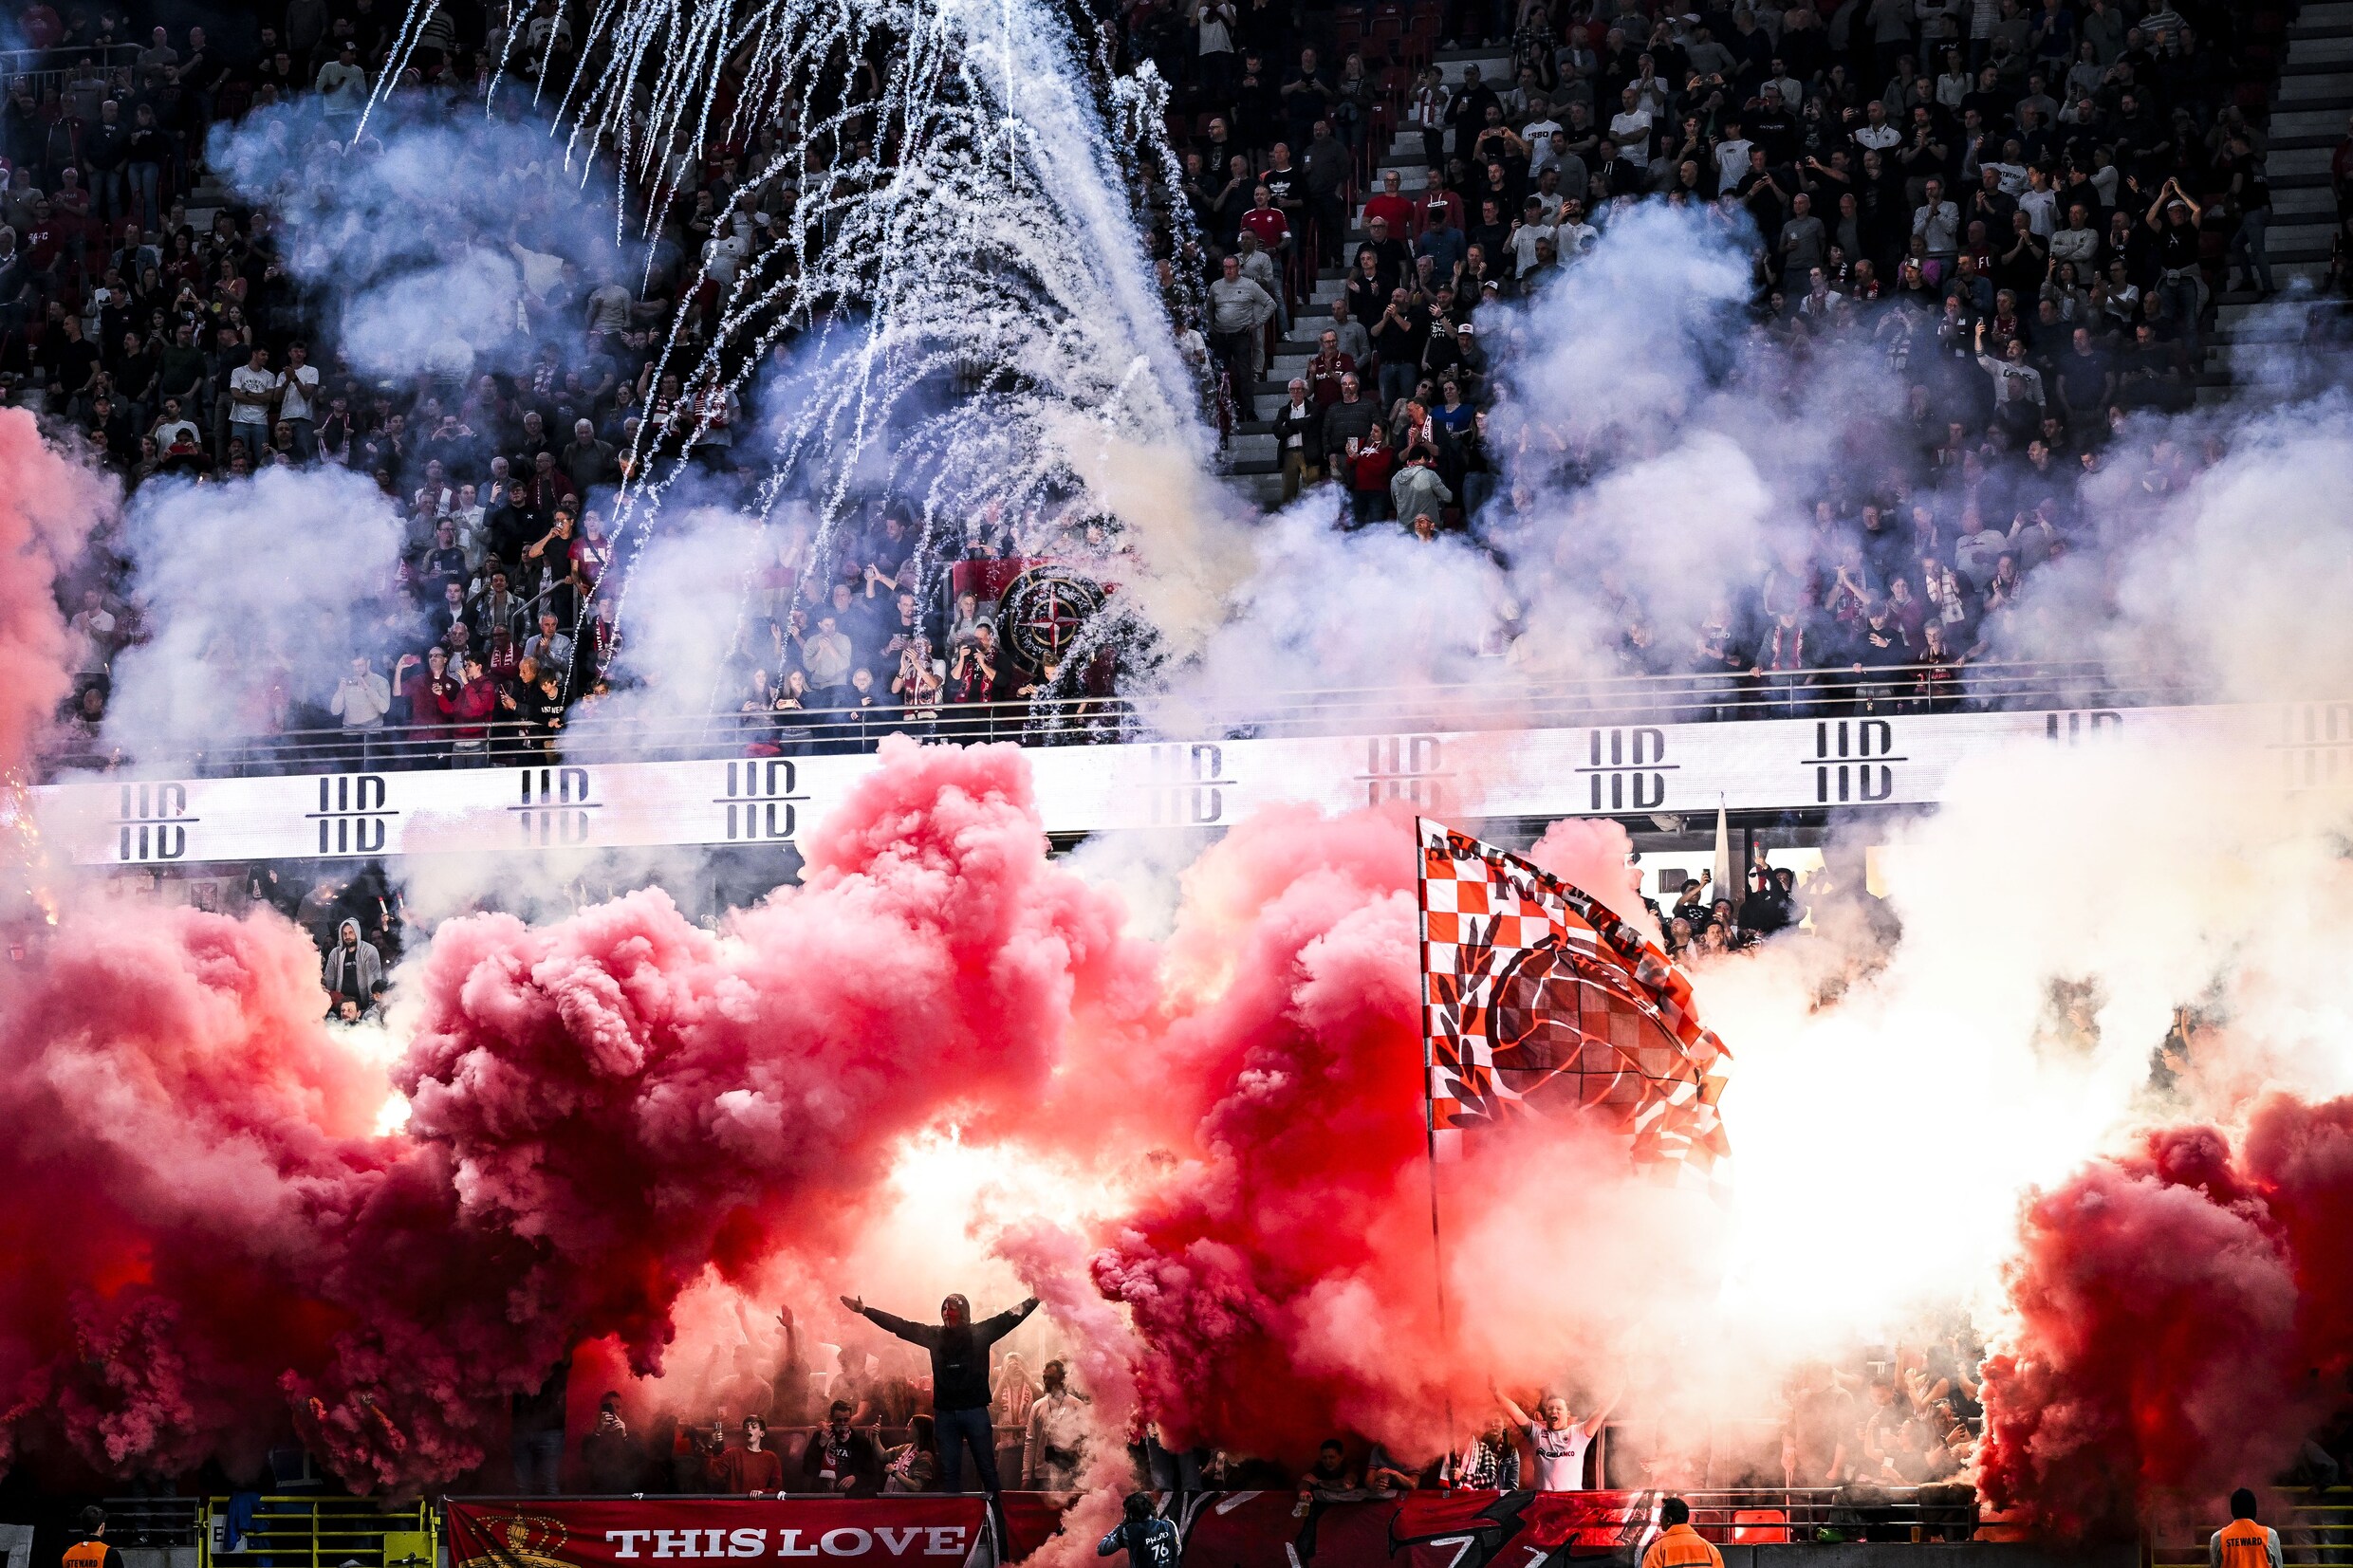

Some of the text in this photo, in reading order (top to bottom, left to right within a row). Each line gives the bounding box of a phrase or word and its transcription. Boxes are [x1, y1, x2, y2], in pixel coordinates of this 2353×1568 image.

[1999, 172, 2021, 180] NTWERP
[541, 706, 565, 714] ANTWER
[606, 1526, 966, 1558] THIS LOVE
[2226, 1537, 2263, 1548] STEWARD
[1151, 1543, 1170, 1560] 76
[66, 1559, 98, 1568] STEWARD
